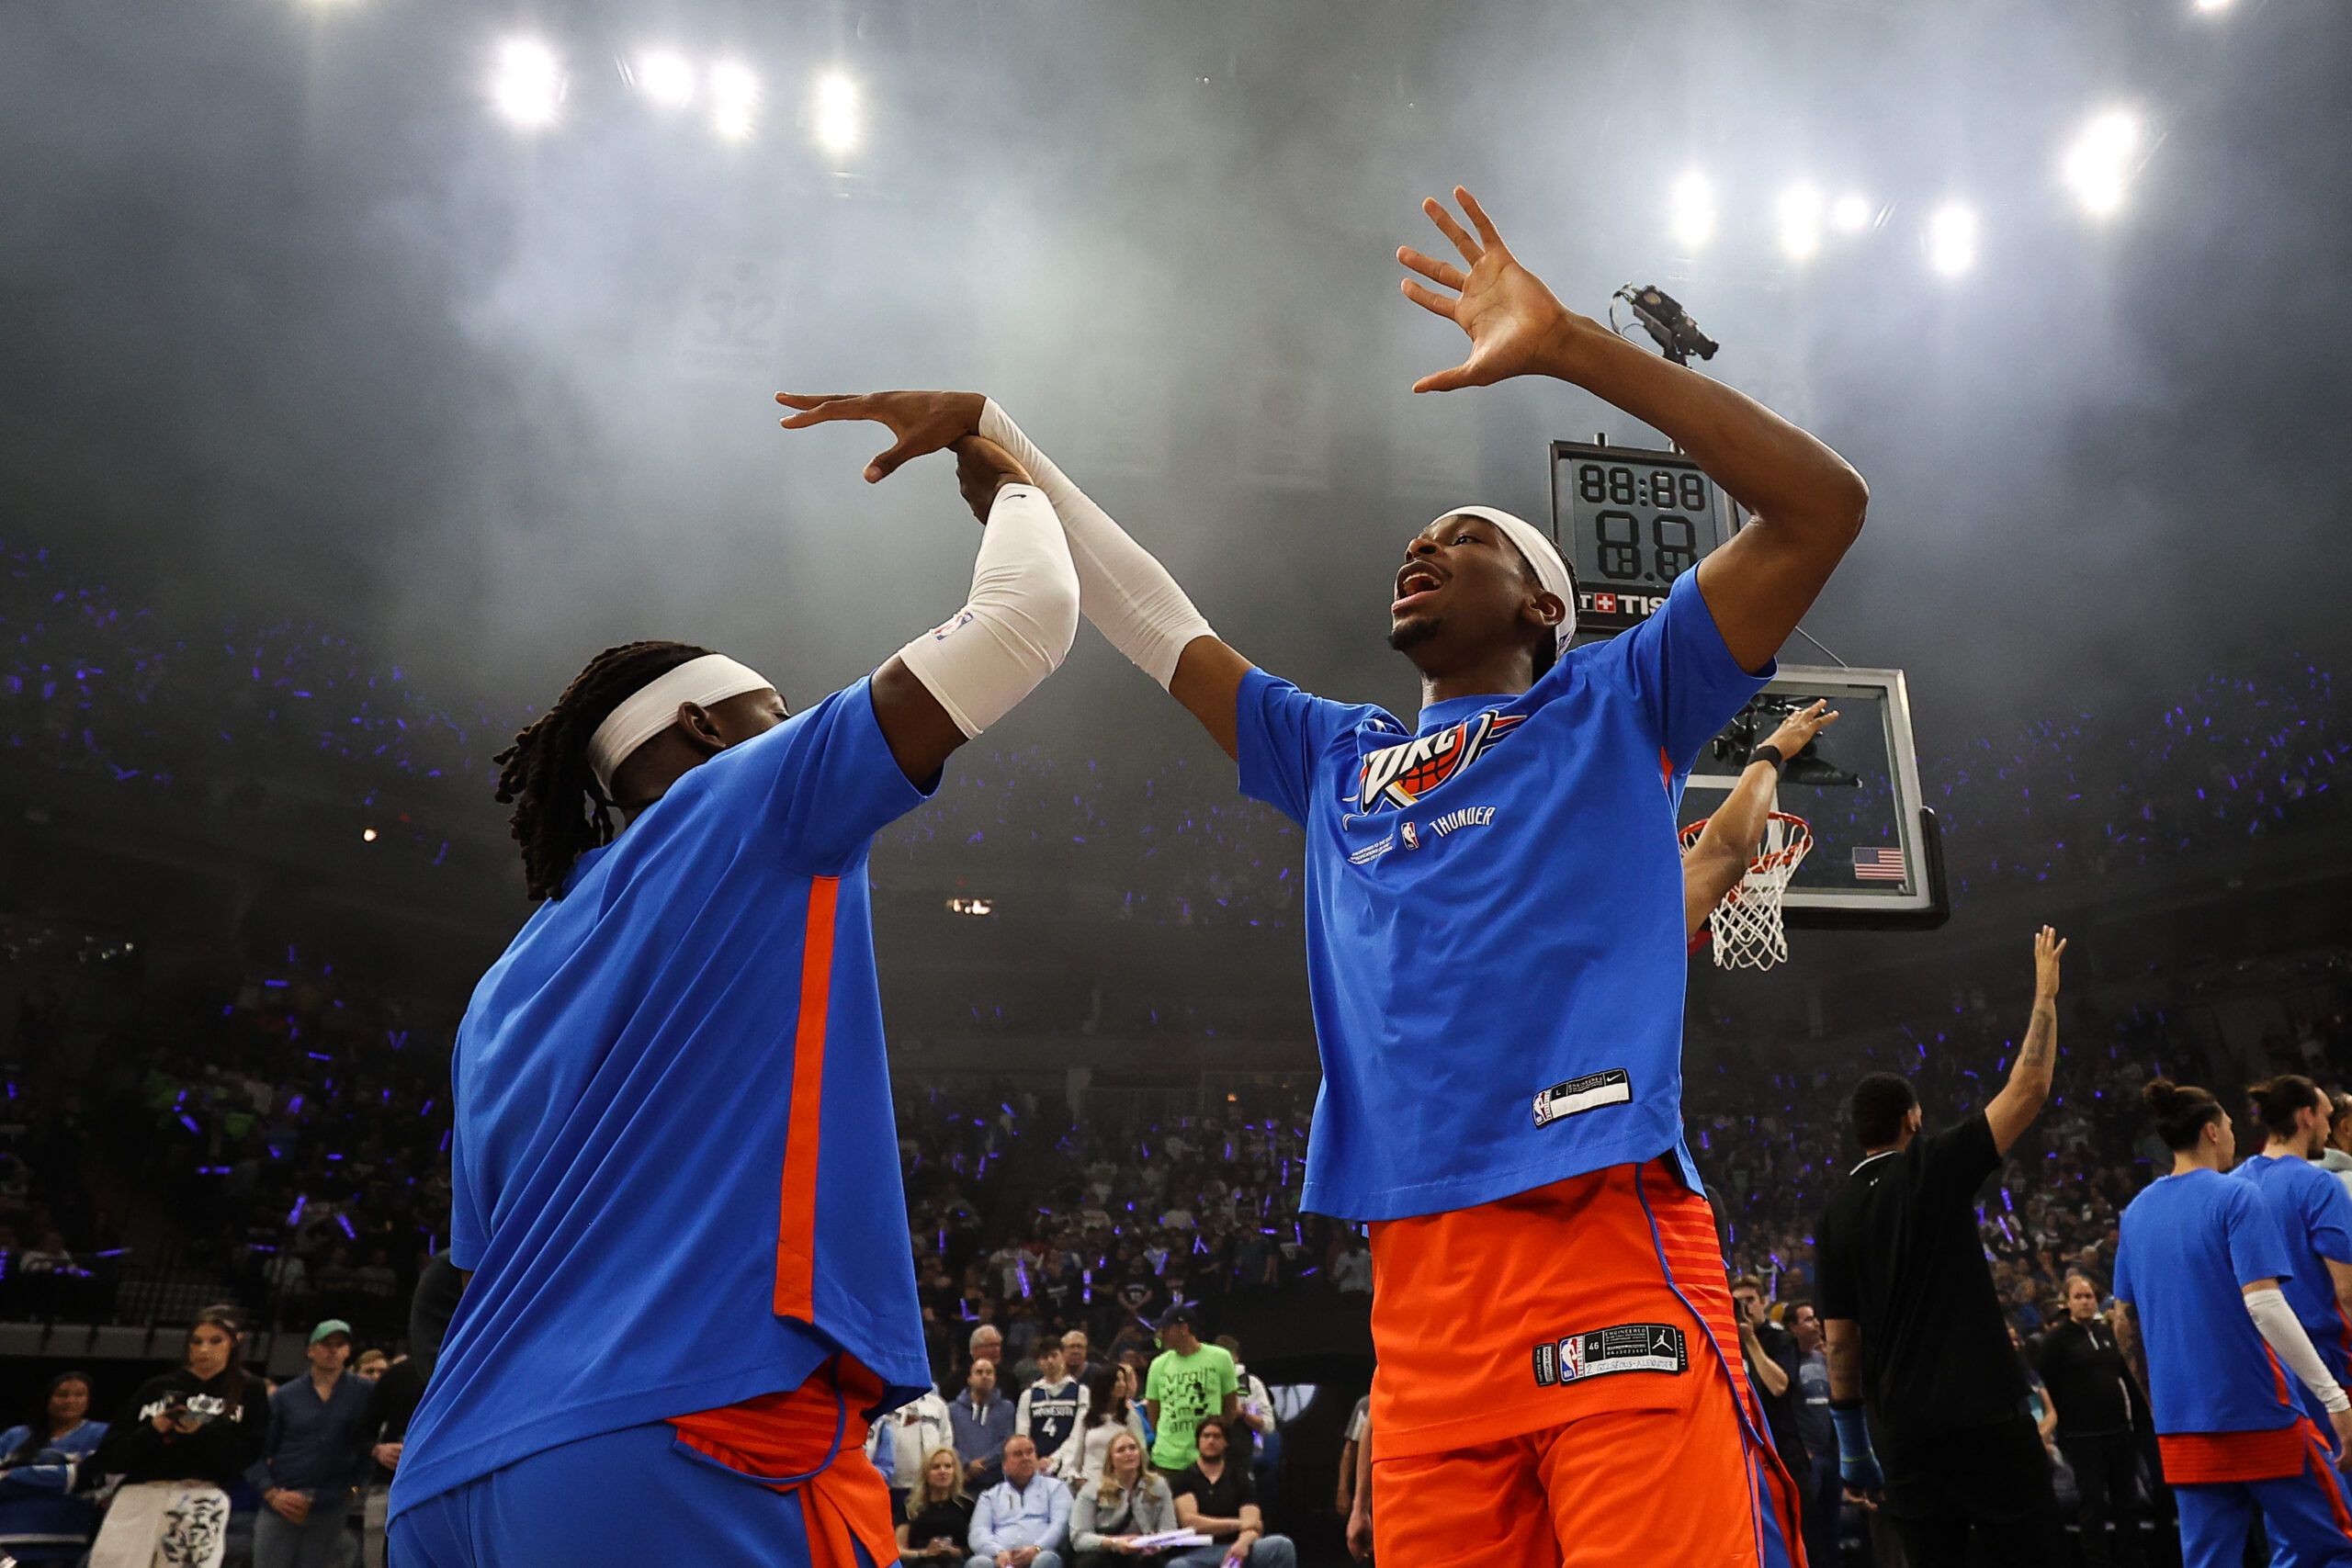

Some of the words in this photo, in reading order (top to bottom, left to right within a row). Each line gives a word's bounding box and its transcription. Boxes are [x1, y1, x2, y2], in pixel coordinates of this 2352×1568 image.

[1579, 464, 1705, 512] 88:88
[1618, 595, 1665, 615] TIS
[1429, 807, 1496, 837] THUNDER
[1589, 1341, 1600, 1350] 46
[1587, 1363, 1592, 1374] 2
[1042, 1416, 1057, 1438] 4
